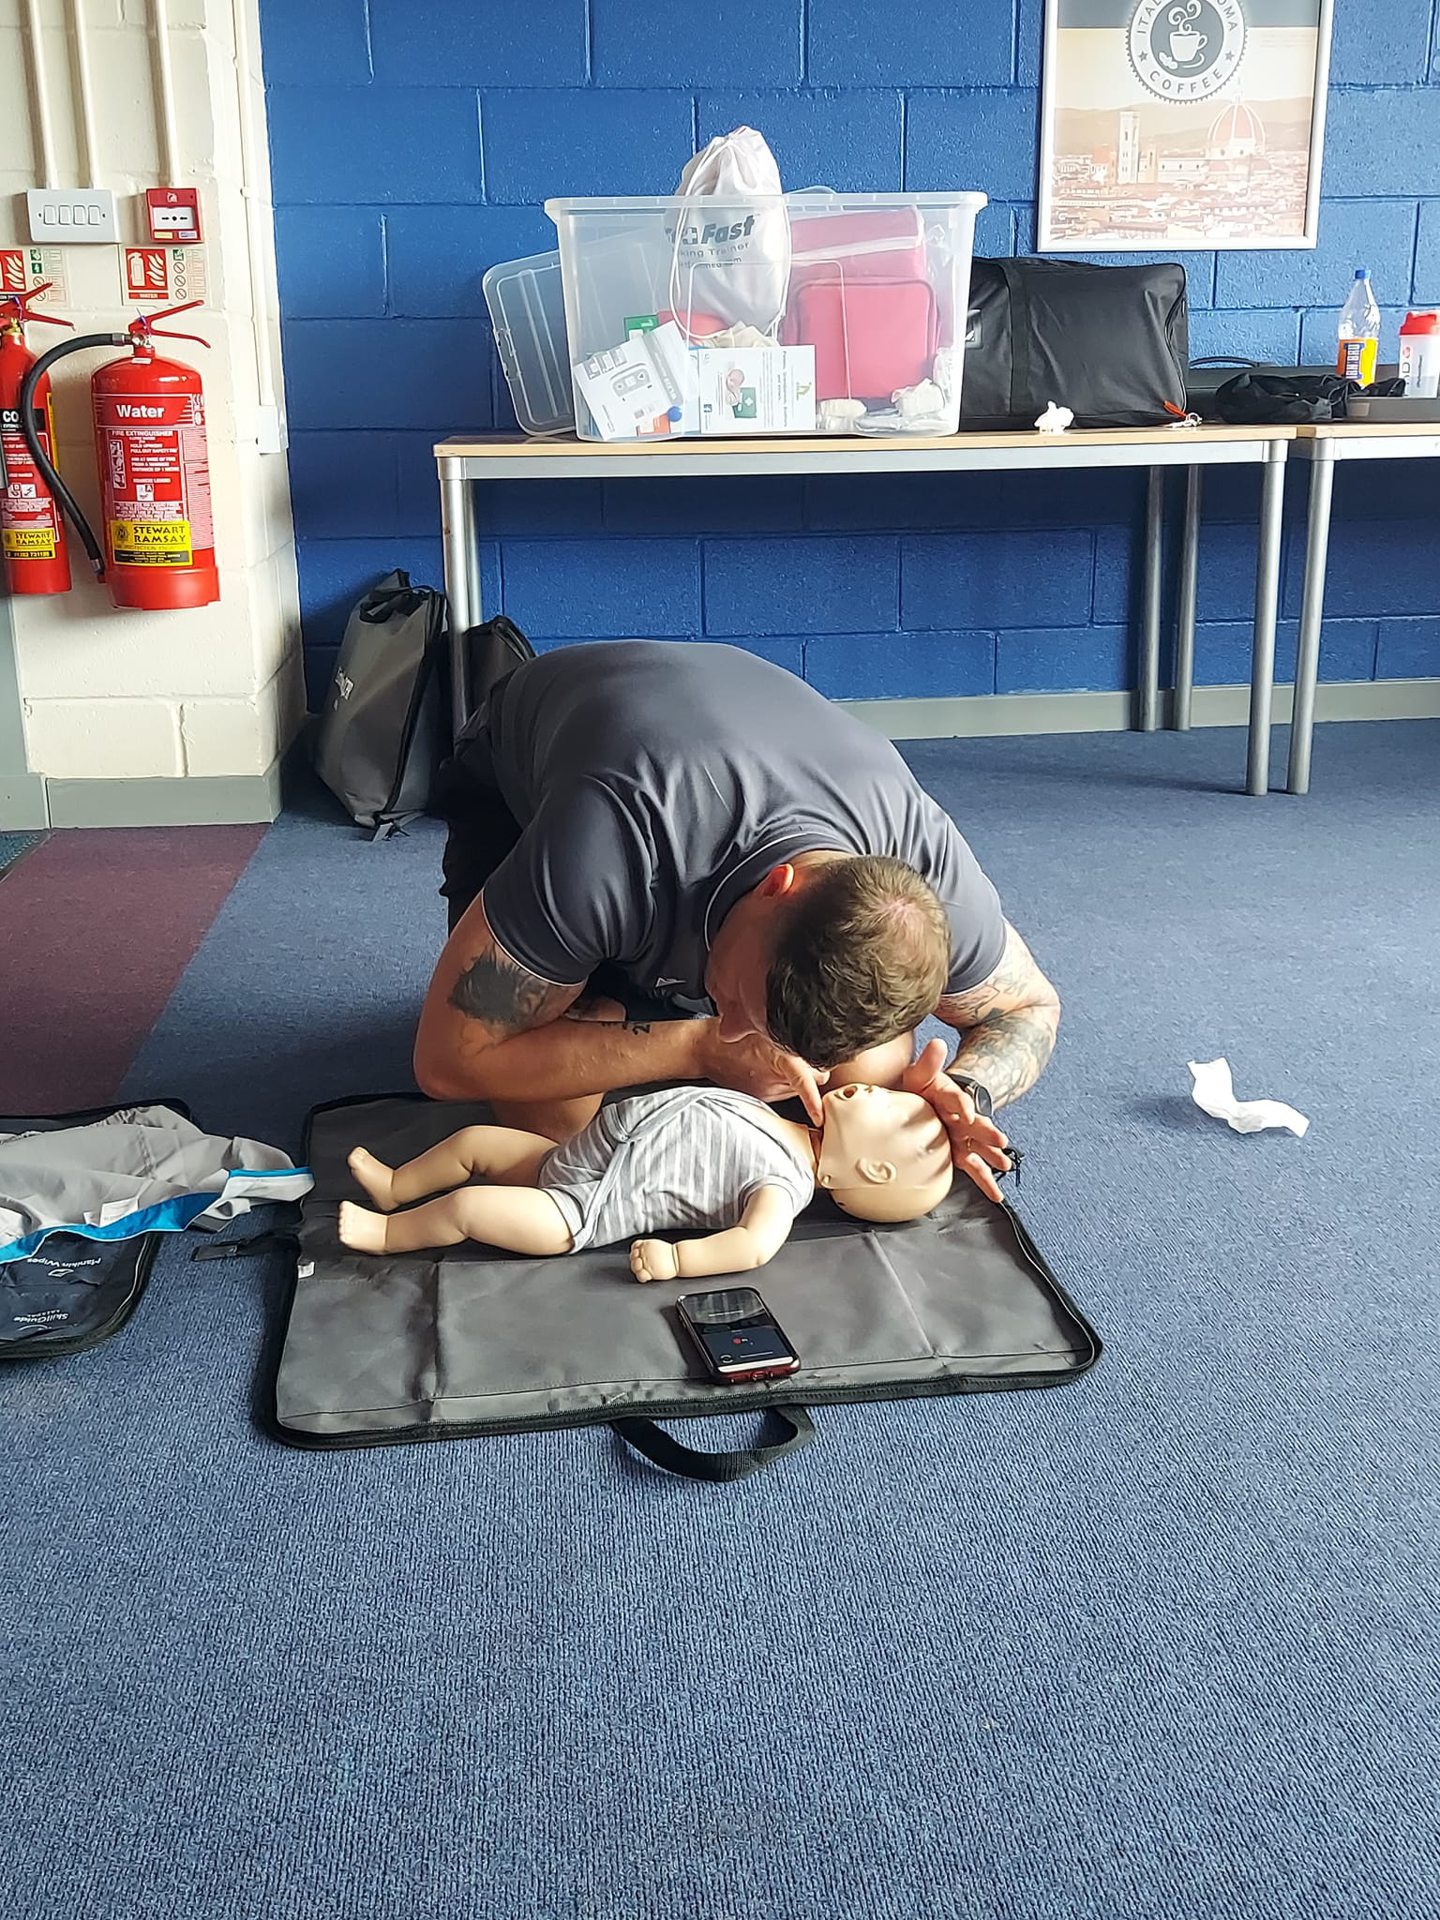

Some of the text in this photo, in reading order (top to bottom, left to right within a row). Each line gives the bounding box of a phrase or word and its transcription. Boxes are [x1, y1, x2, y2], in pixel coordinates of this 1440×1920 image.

[1149, 69, 1222, 94] COFFEE
[701, 214, 755, 245] Fast
[116, 404, 165, 418] Water
[134, 526, 185, 534] STEWART
[134, 535, 186, 543] RAMSAY
[26, 1257, 102, 1268] Manikin Wipes
[13, 1313, 69, 1324] SkillGuide
